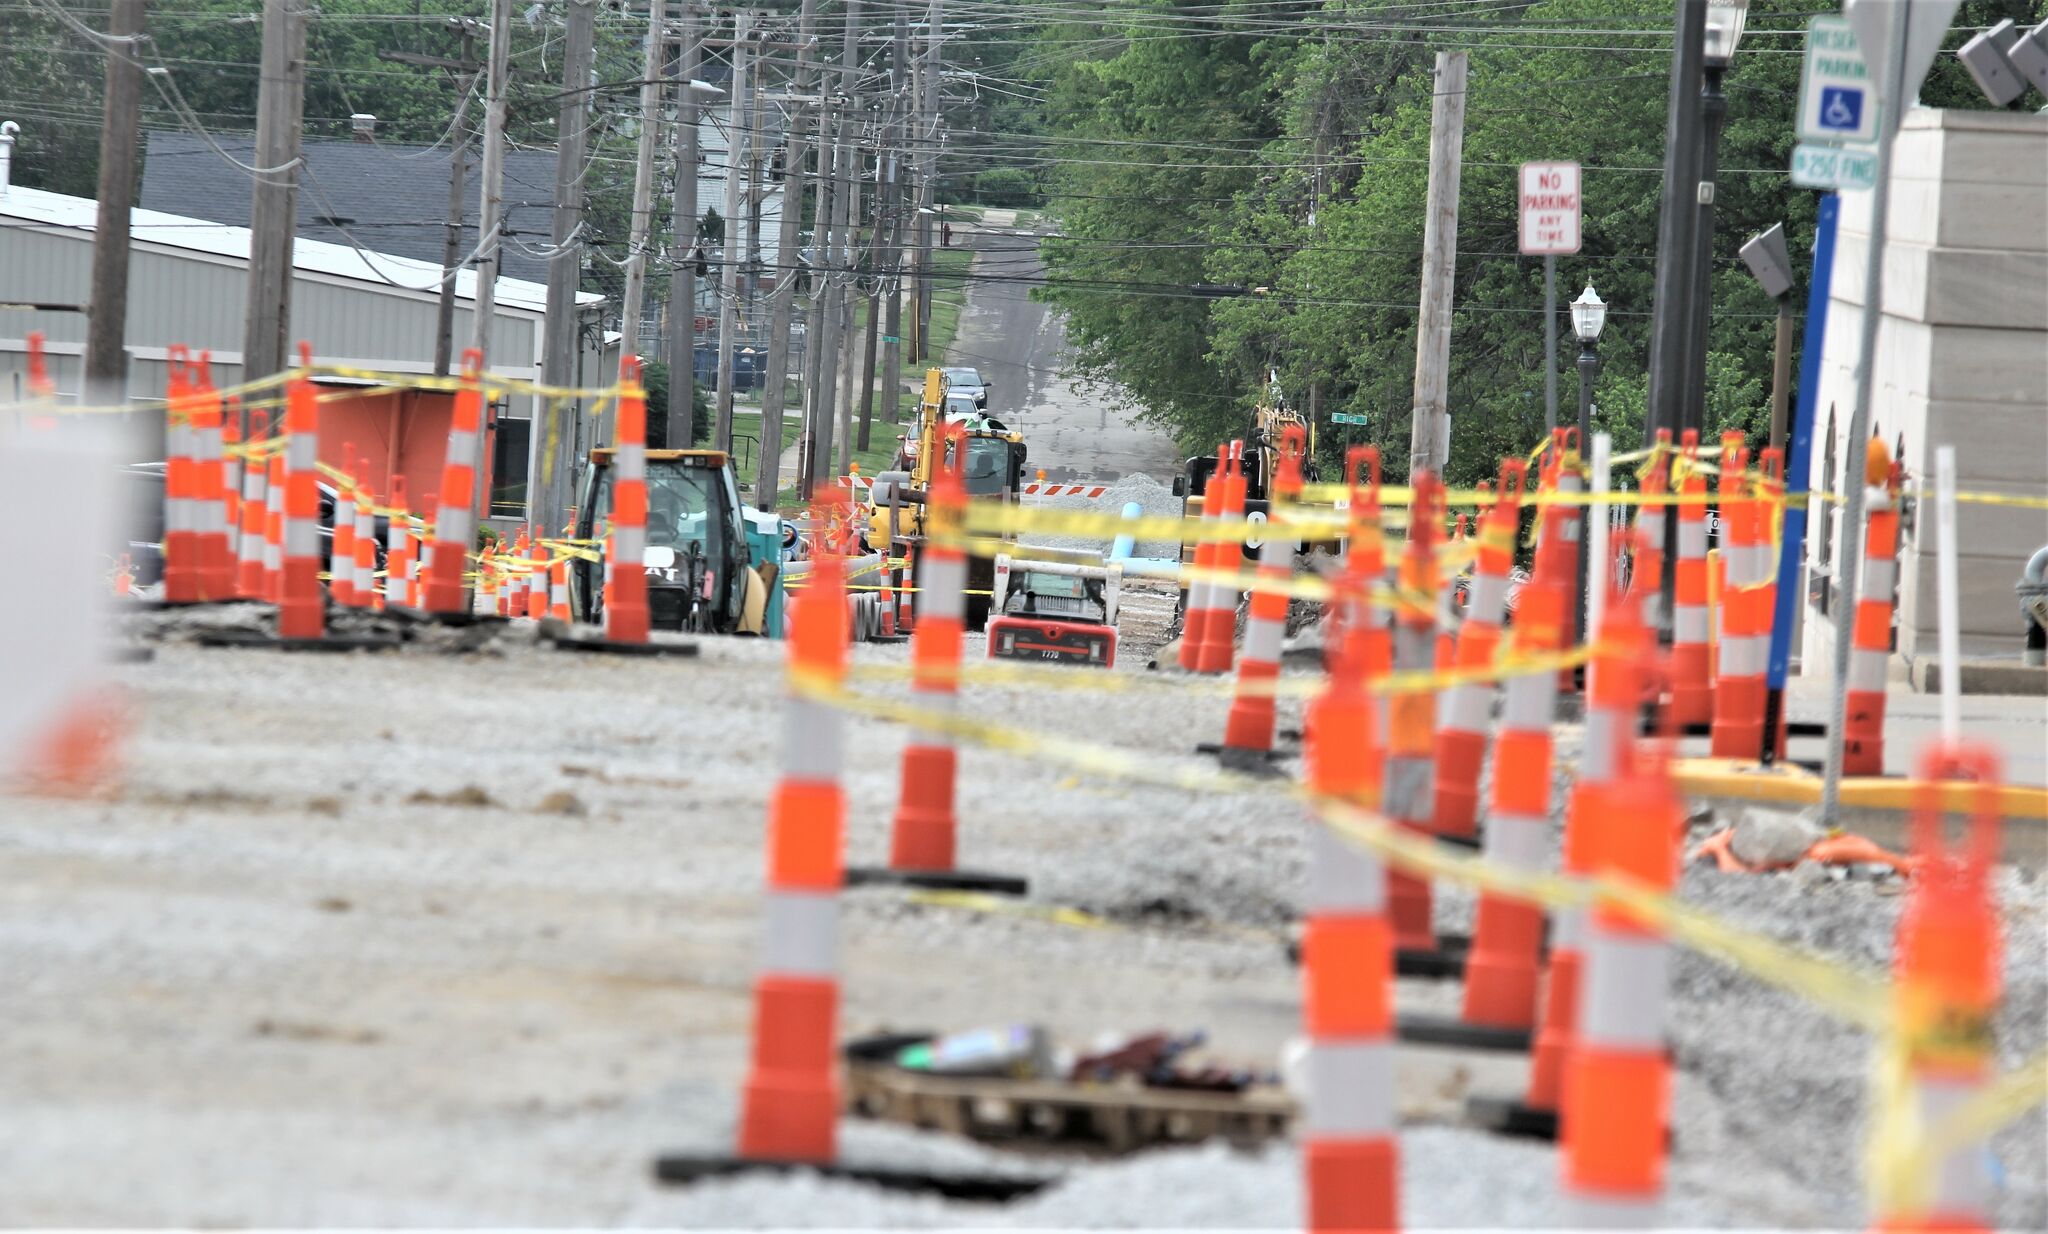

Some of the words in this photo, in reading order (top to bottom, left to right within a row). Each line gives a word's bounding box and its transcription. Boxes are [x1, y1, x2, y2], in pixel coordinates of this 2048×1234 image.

[1813, 28, 1857, 50] RESER
[1539, 173, 1561, 189] NO
[1524, 193, 1577, 210] PARKING
[1539, 215, 1561, 226] ANY
[1537, 230, 1563, 242] TIME
[643, 567, 679, 582] AT
